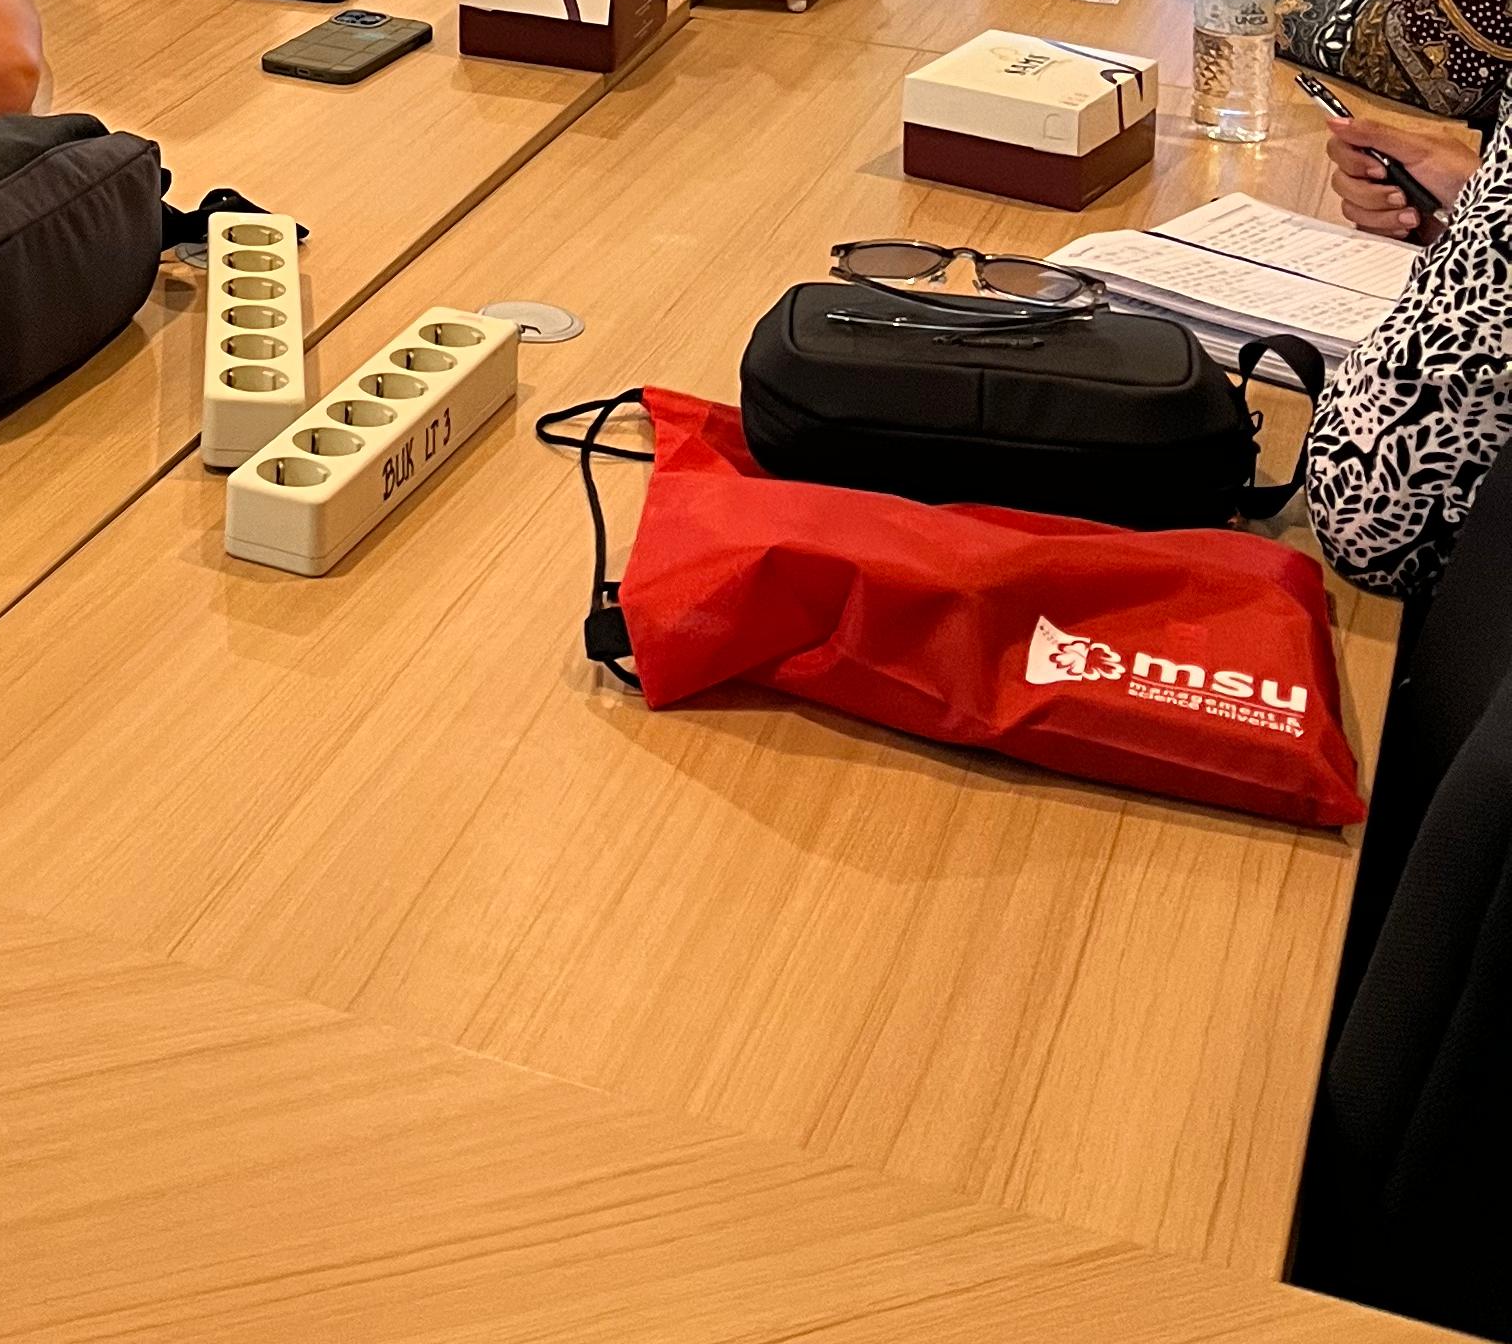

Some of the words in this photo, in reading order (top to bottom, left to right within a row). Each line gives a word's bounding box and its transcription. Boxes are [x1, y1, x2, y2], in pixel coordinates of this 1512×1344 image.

[443, 407, 451, 446] 3
[1129, 681, 1276, 721] management
[1132, 651, 1308, 713] msu
[1128, 688, 1201, 711] science
[1205, 705, 1305, 738] university
